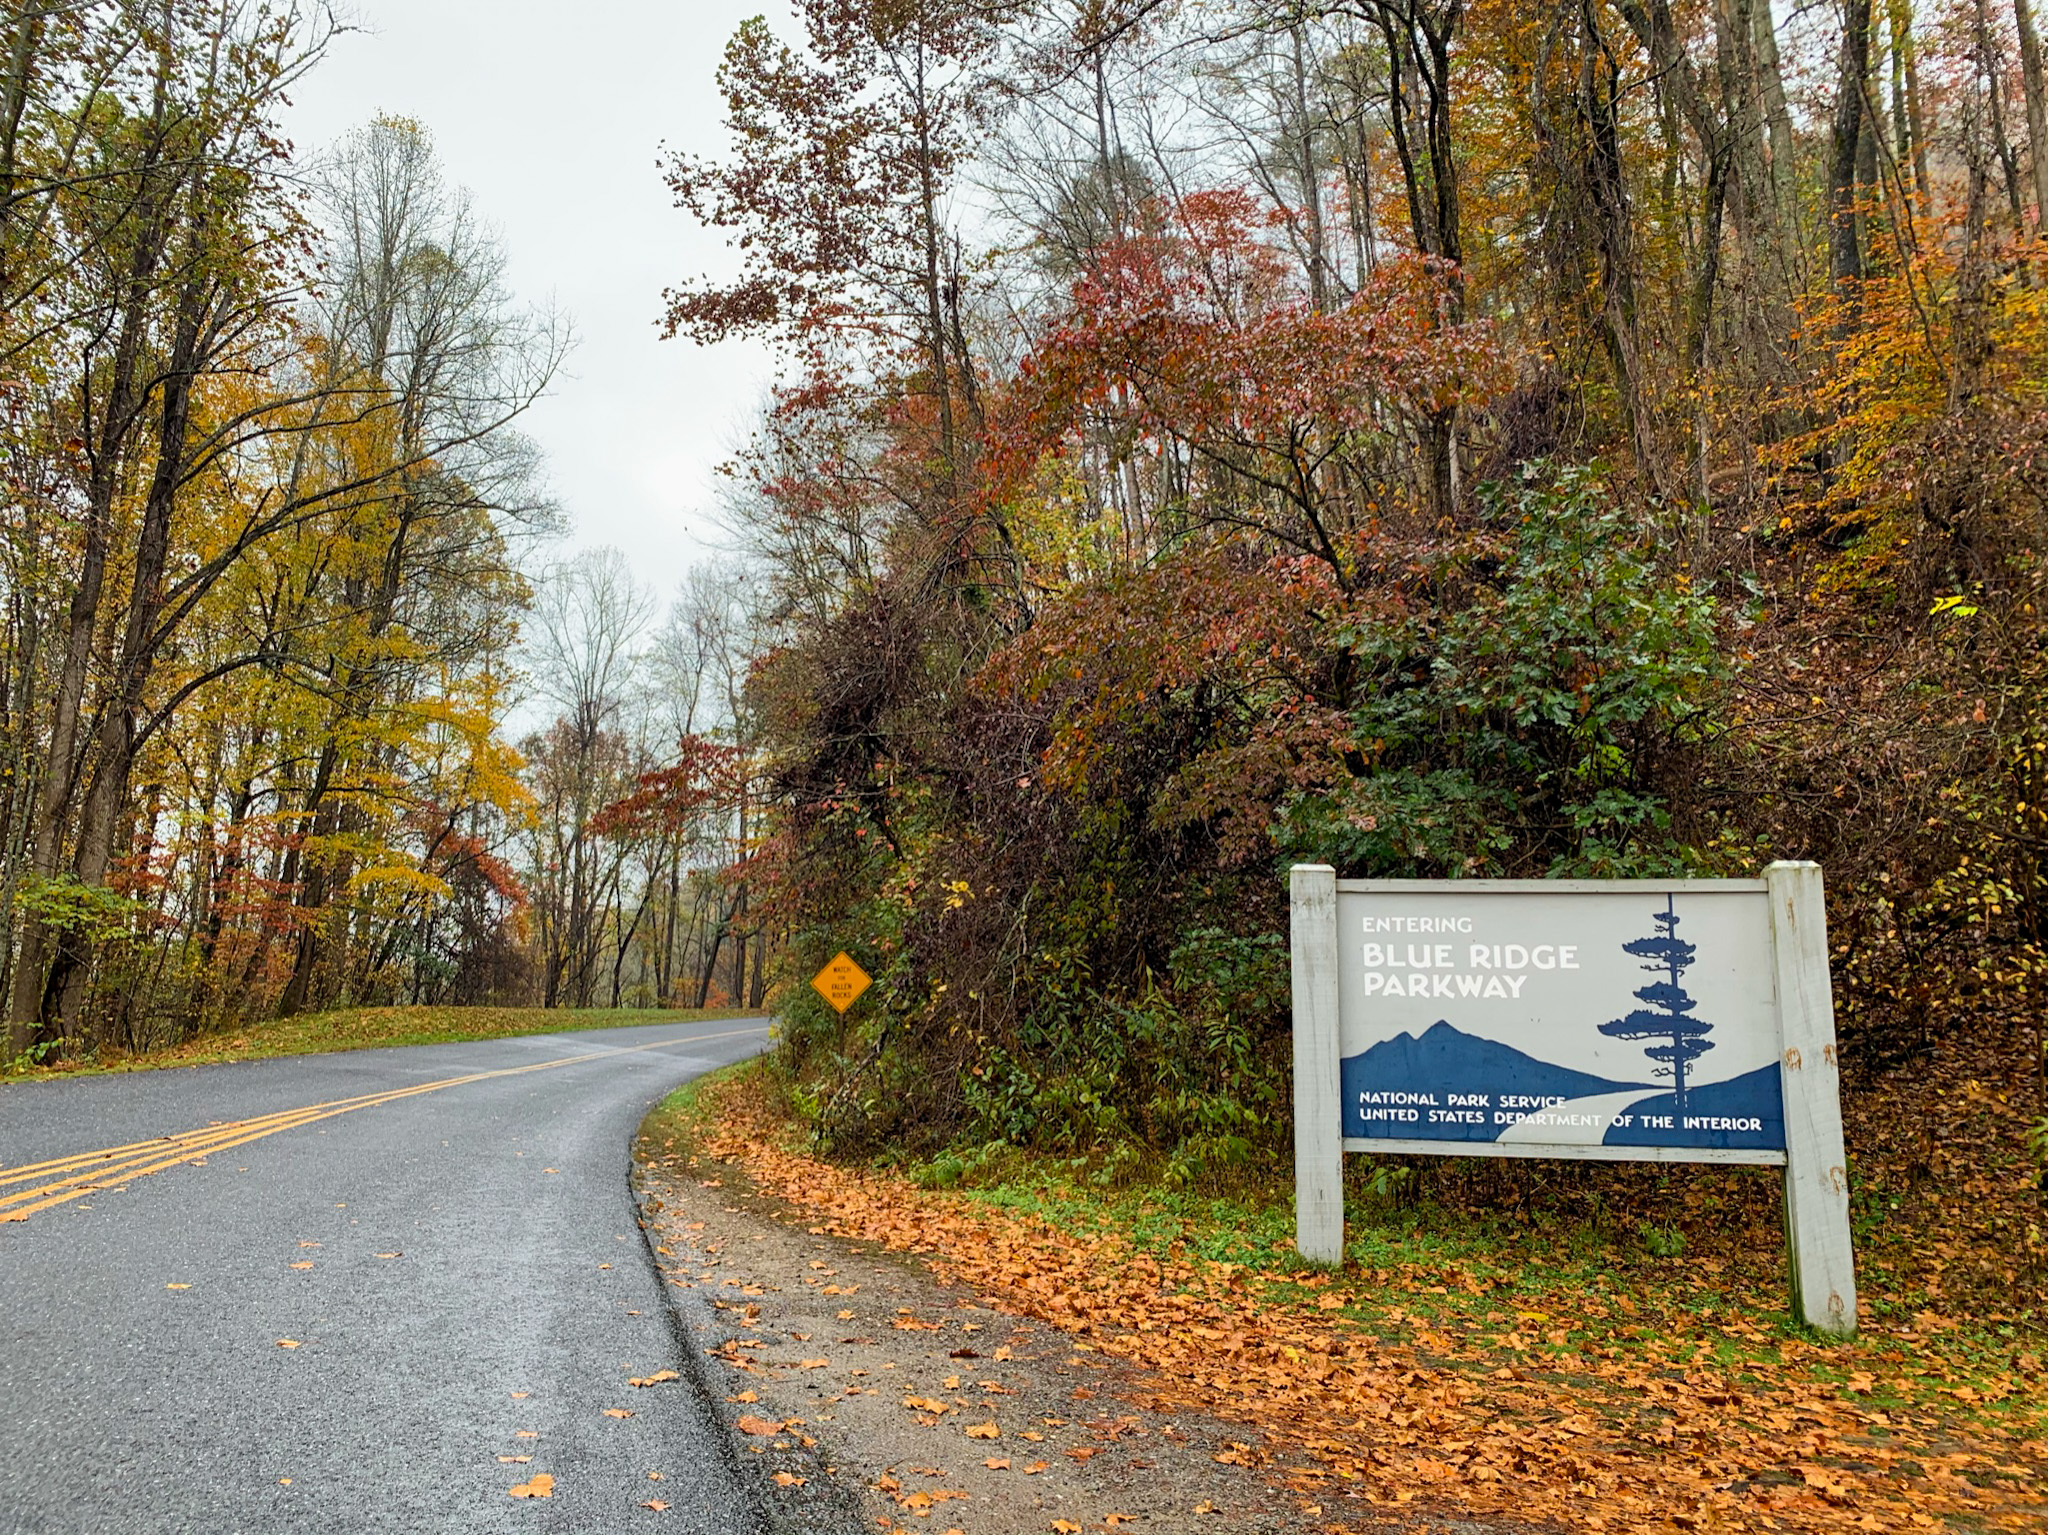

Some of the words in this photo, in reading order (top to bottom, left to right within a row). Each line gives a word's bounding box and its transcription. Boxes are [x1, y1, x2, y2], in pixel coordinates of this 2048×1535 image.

[1362, 917, 1472, 933] ENTERING
[1363, 943, 1454, 969] BLUE
[1469, 944, 1580, 970] RIDGE
[1363, 971, 1528, 999] PARKWAY
[1359, 1092, 1439, 1106] NATIONAL
[1448, 1094, 1490, 1107] PARK
[1499, 1095, 1566, 1109] SERVICE
[1359, 1108, 1419, 1122] UNITED
[1428, 1110, 1485, 1124] STATES
[1494, 1111, 1601, 1127] DEPARTMENT
[1611, 1114, 1635, 1128] OF
[1641, 1115, 1674, 1129] THE
[1683, 1116, 1762, 1131] INTERIOR
